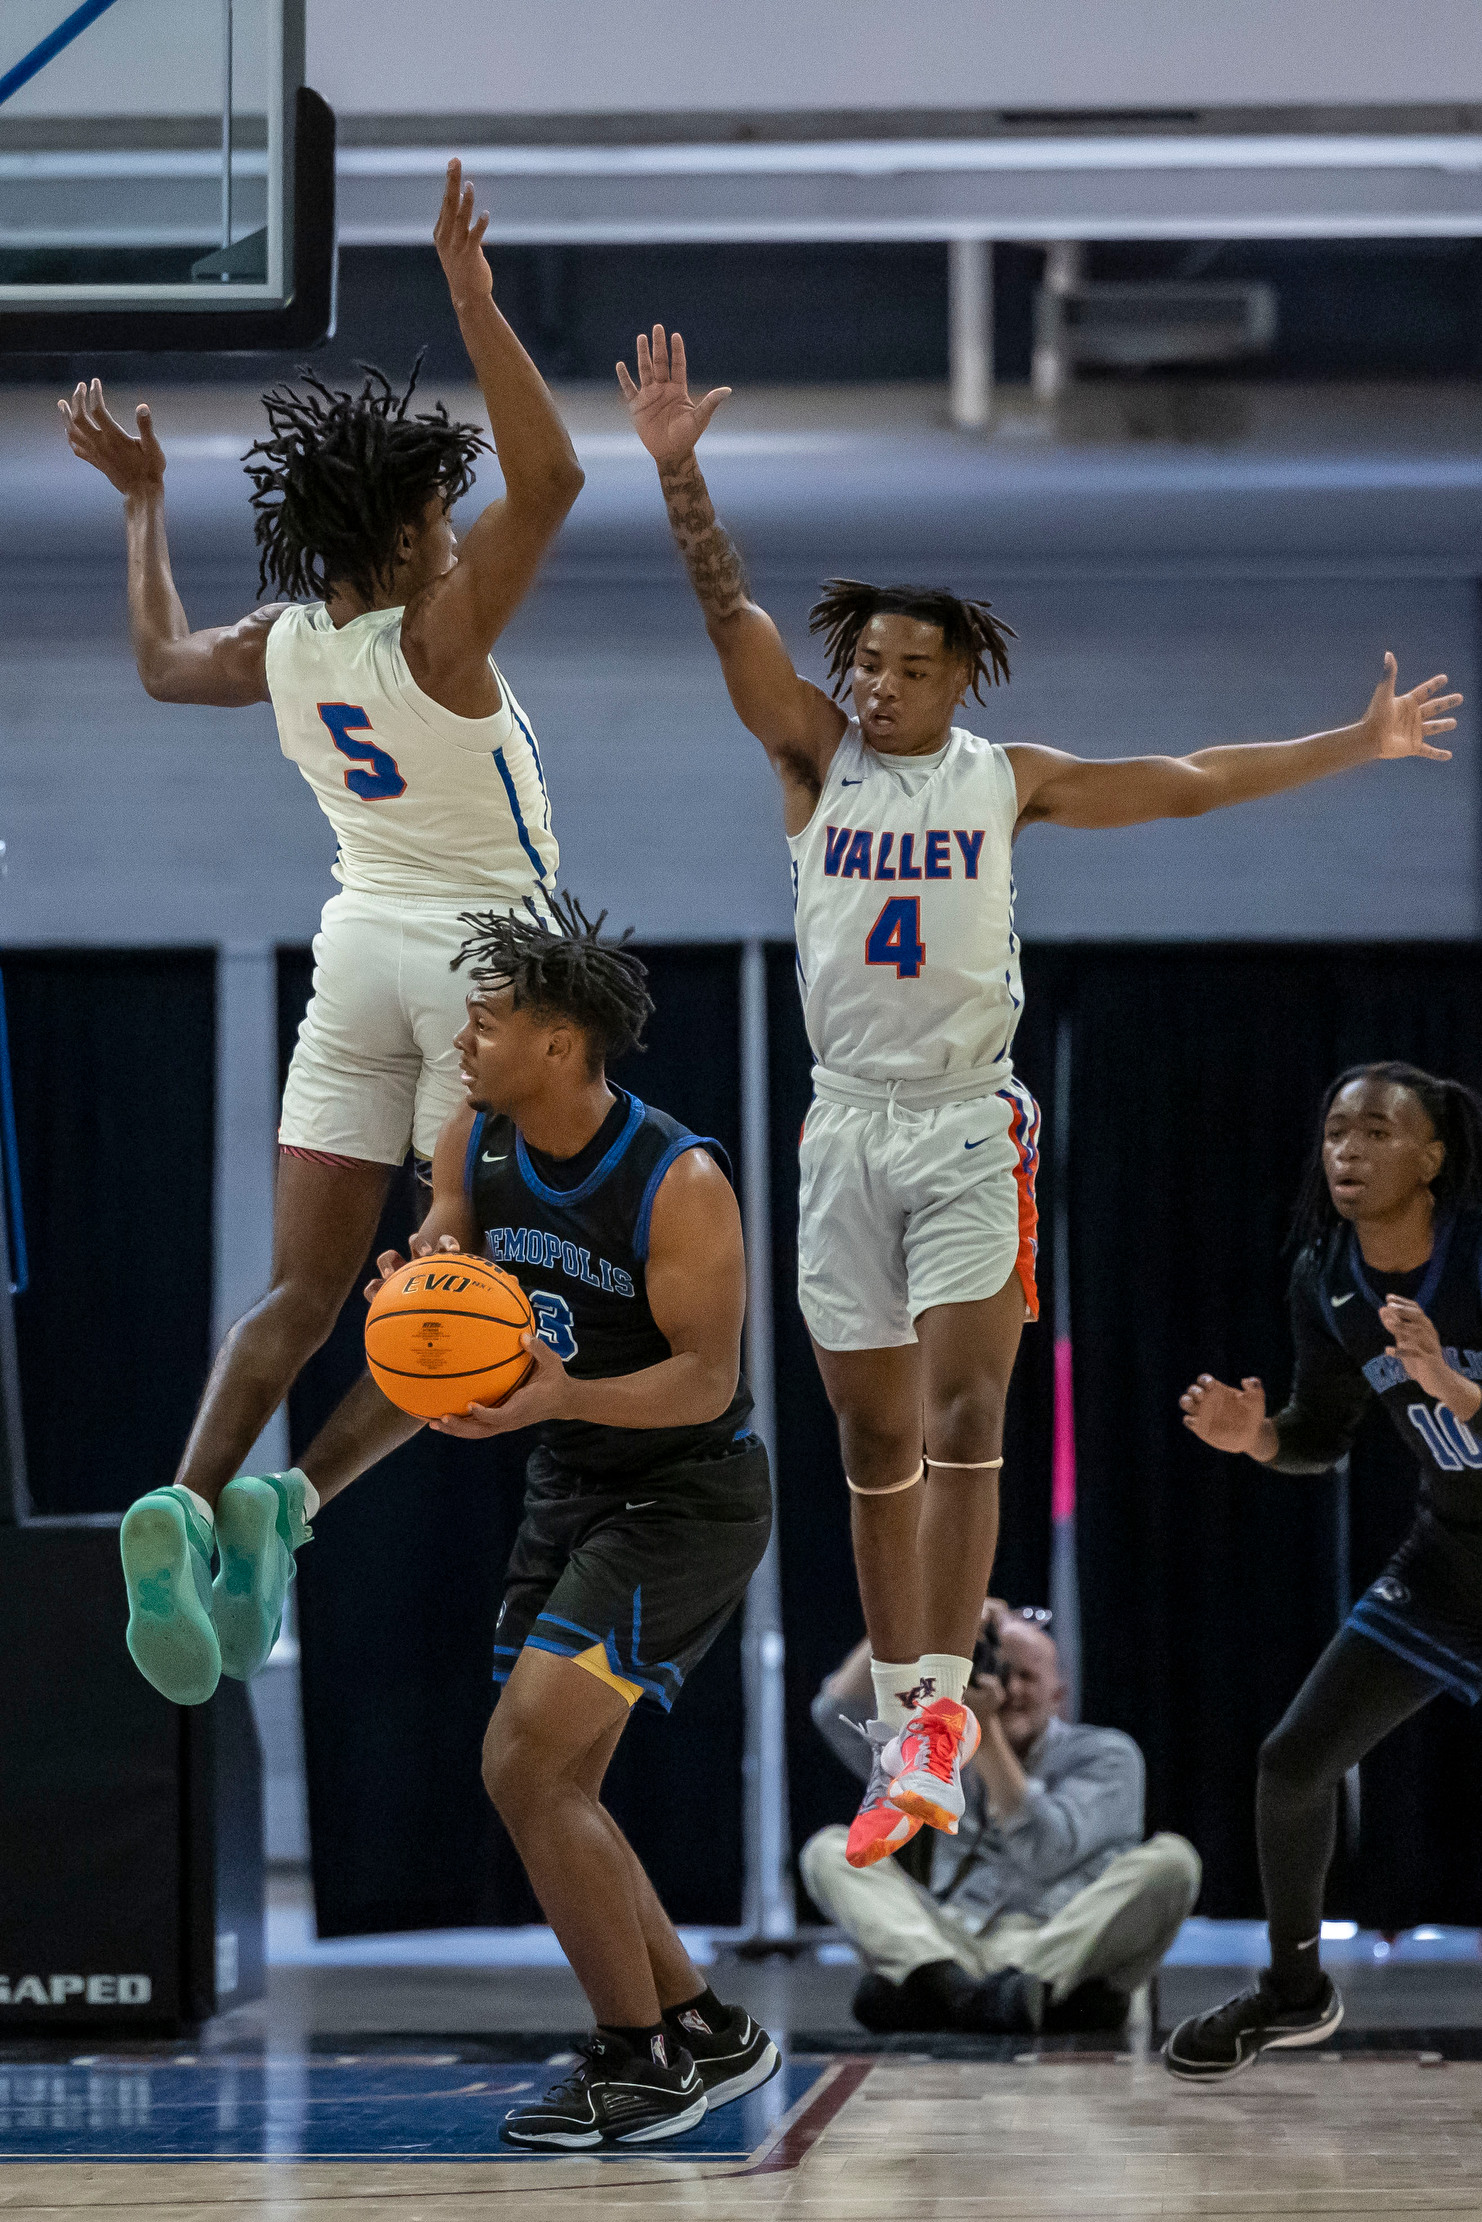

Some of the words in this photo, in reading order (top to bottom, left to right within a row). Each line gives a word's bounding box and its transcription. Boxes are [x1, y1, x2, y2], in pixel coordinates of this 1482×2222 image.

[316, 702, 408, 801] 5
[824, 826, 986, 881] VALLEY
[865, 896, 926, 980] 4
[402, 1273, 471, 1294] EVO
[485, 1227, 635, 1298] EMOPOLIS
[529, 1289, 579, 1362] 3
